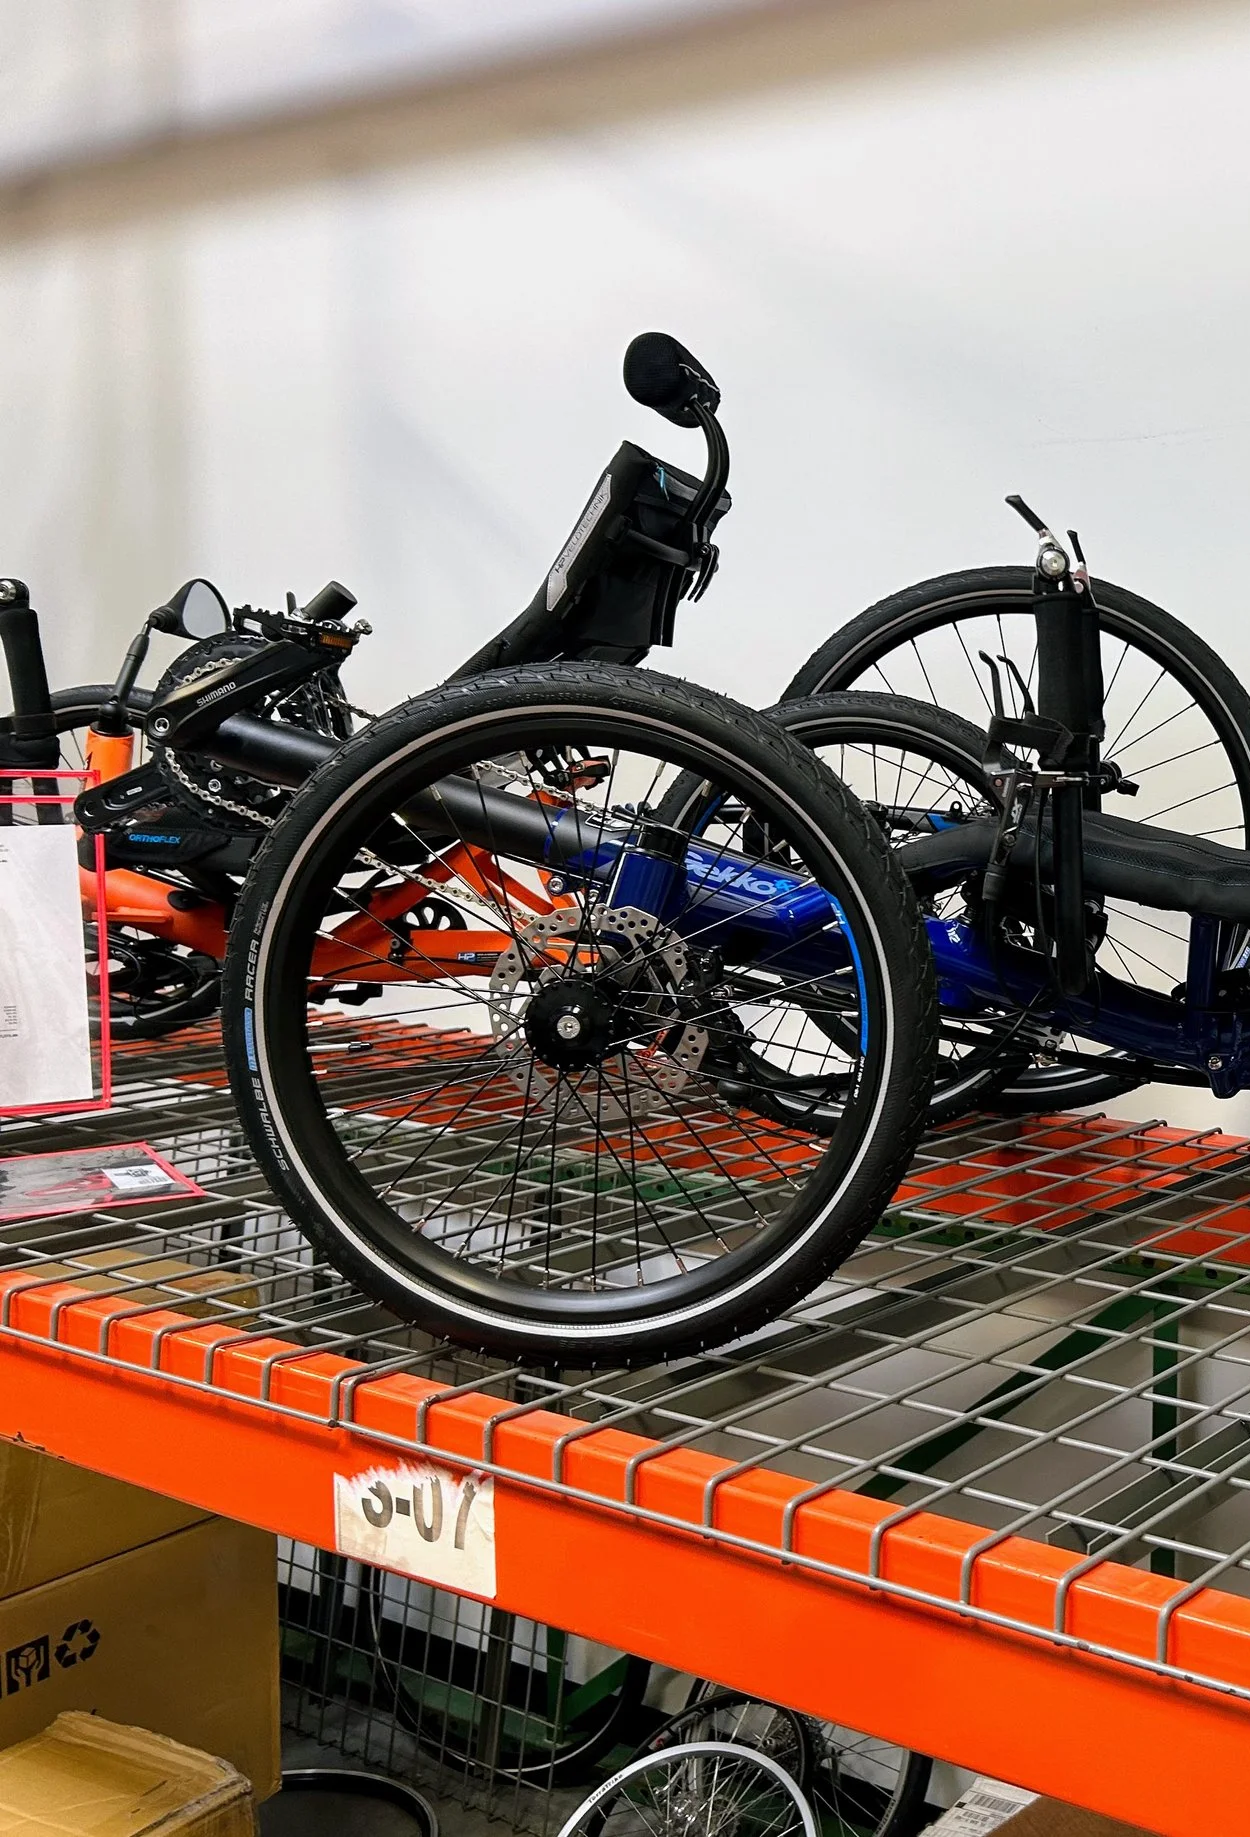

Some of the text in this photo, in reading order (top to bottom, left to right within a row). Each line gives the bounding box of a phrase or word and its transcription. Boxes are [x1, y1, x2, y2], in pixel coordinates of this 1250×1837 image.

[196, 681, 237, 707] SHIMANO
[128, 833, 181, 844] ORTHOFLEX
[244, 939, 260, 1002] RACER
[250, 1077, 290, 1171] SCHWALBE
